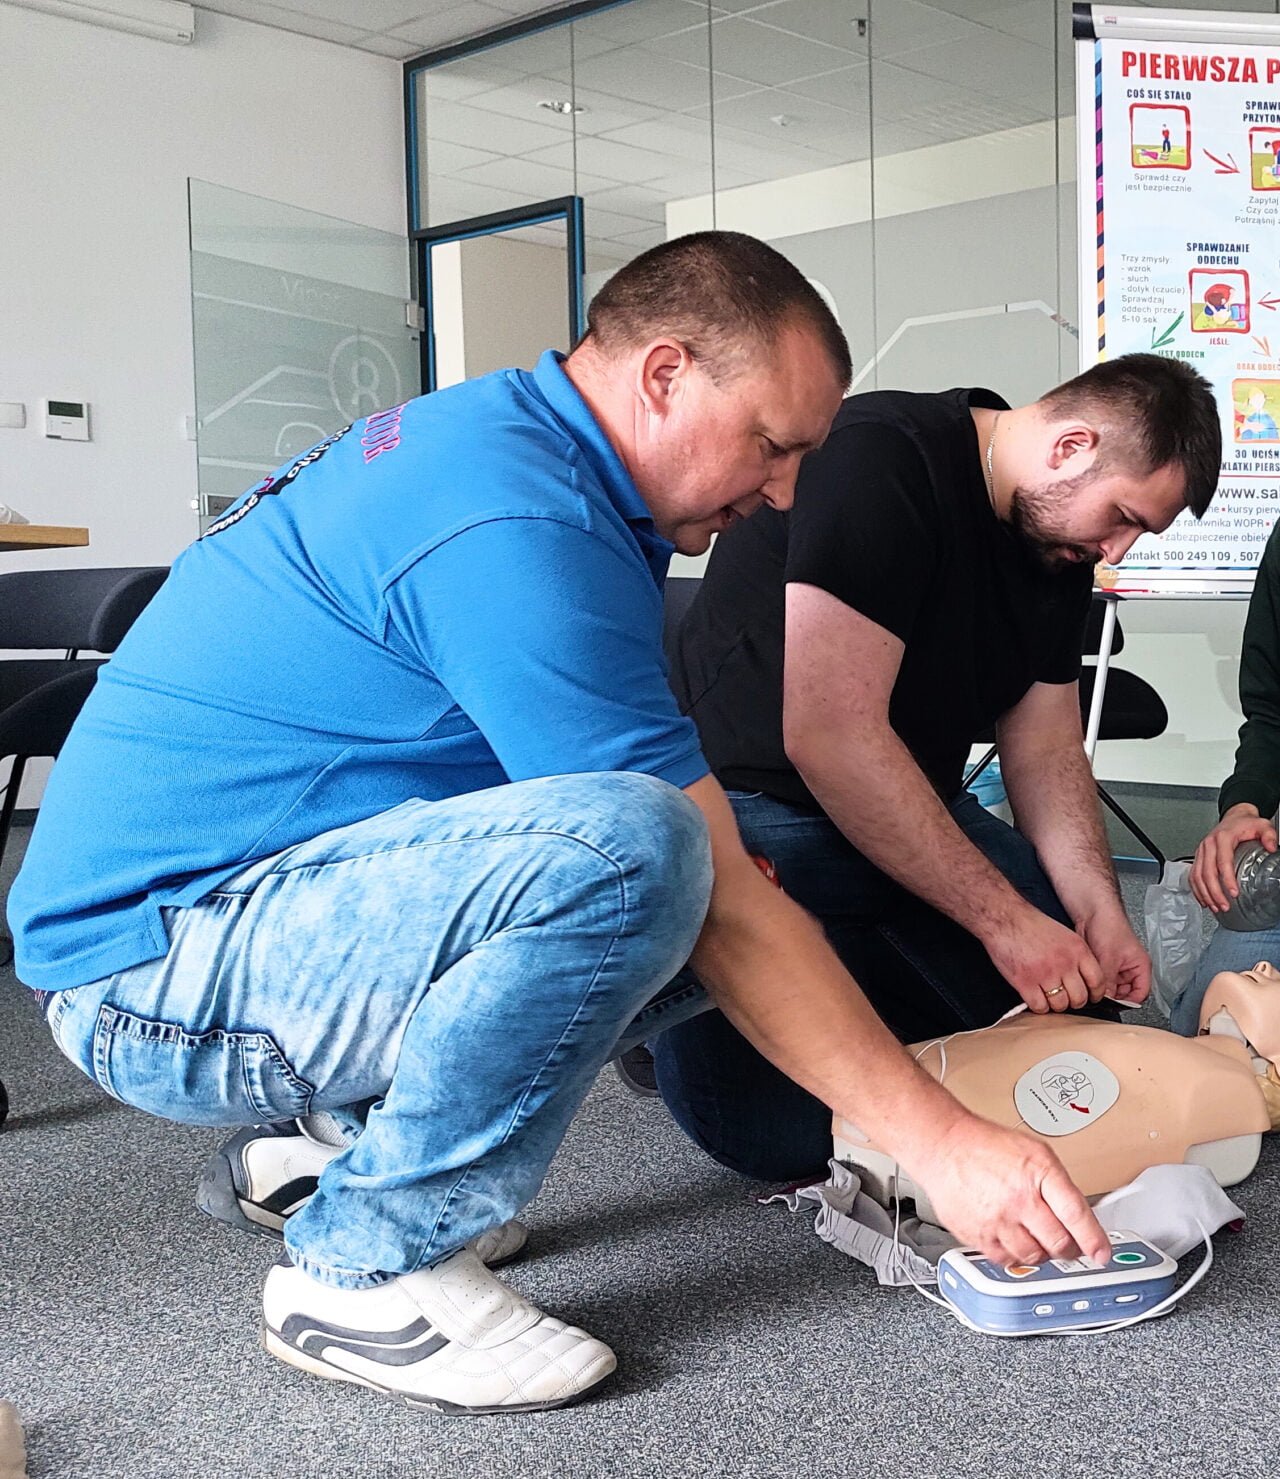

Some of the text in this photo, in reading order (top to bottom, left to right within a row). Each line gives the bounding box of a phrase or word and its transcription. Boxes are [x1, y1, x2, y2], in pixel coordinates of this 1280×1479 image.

[1122, 51, 1258, 83] PIERWSZA
[1127, 88, 1192, 100] COŚ SIĘ STAŁO
[1172, 175, 1186, 183] czy
[1125, 183, 1140, 192] jest
[1249, 196, 1279, 206] Zapytaj
[1246, 206, 1261, 215] Czy
[1186, 242, 1250, 253] SPRAWDZANIE
[1121, 254, 1139, 263] Trzy
[1197, 255, 1240, 265] ODDECHU
[1121, 295, 1165, 304] Sprawdzaj
[1154, 307, 1177, 315] przez
[1235, 449, 1247, 459] 30
[1228, 504, 1254, 515] kursy
[1183, 518, 1231, 527] ratownika
[1233, 519, 1264, 527] WOPR
[1165, 532, 1238, 543] zabezpieczenie
[1164, 551, 1184, 560] 500
[1187, 551, 1207, 561] 249
[1211, 552, 1231, 561] 109
[1240, 552, 1260, 561] 507
